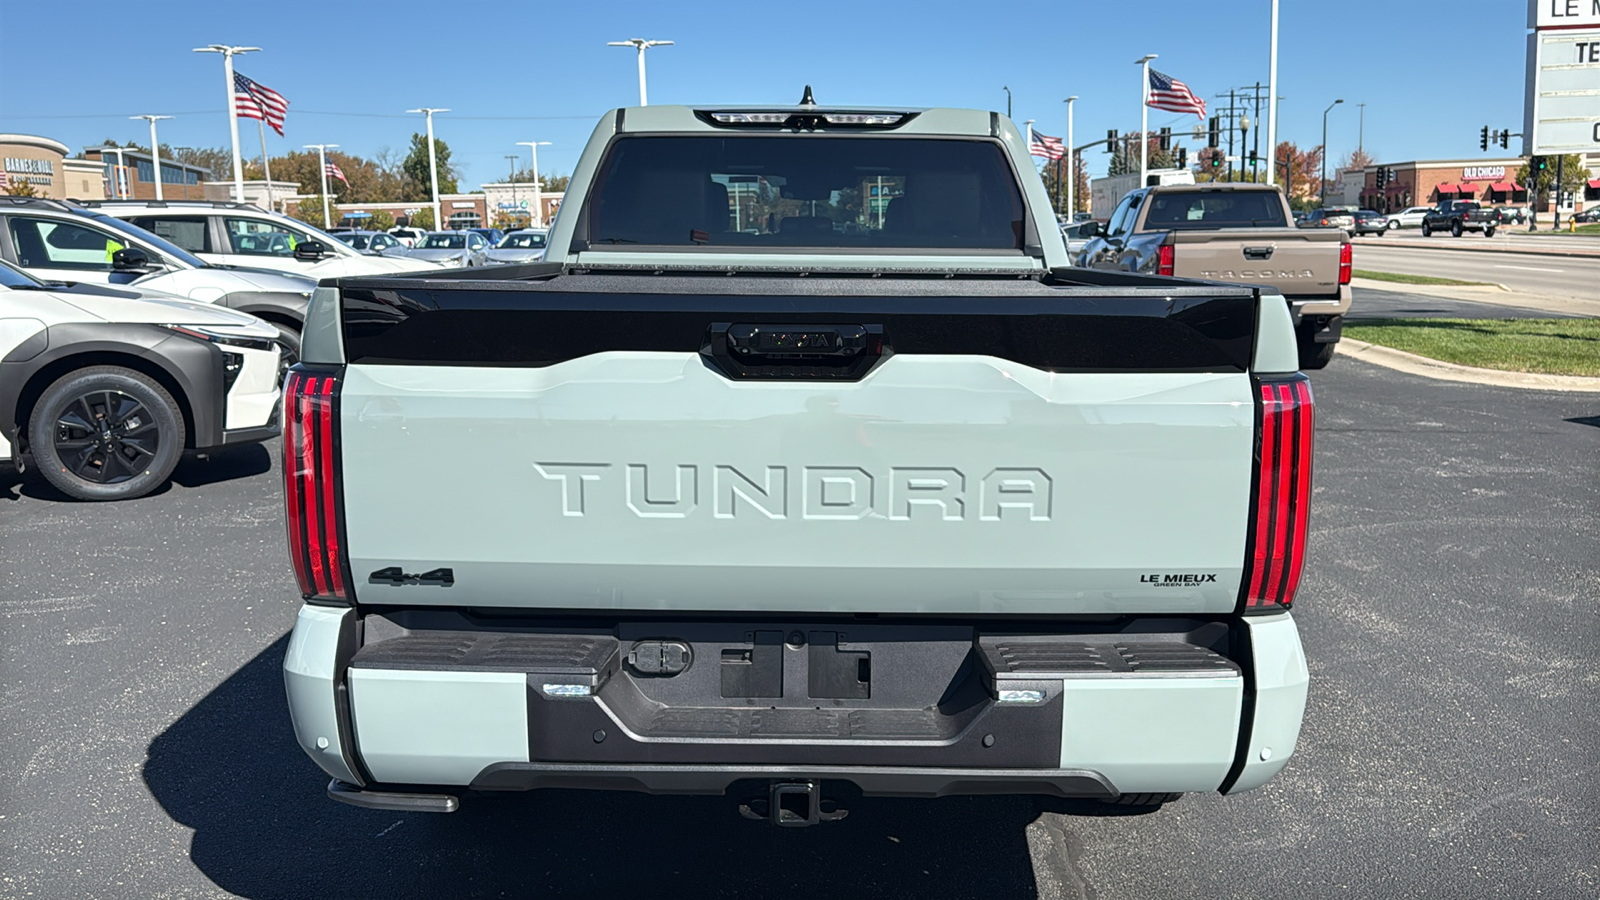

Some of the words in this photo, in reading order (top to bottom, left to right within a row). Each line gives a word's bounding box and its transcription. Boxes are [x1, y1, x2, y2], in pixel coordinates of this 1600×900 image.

[1551, 0, 1579, 17] LE
[1463, 167, 1477, 178] OLD
[1477, 166, 1505, 178] CHICAGO
[1200, 270, 1314, 279] TACOMA
[765, 334, 829, 347] TOYOTA
[533, 462, 1053, 522] TUNDRA
[1140, 574, 1160, 583] LE
[1164, 574, 1218, 583] MIEUX
